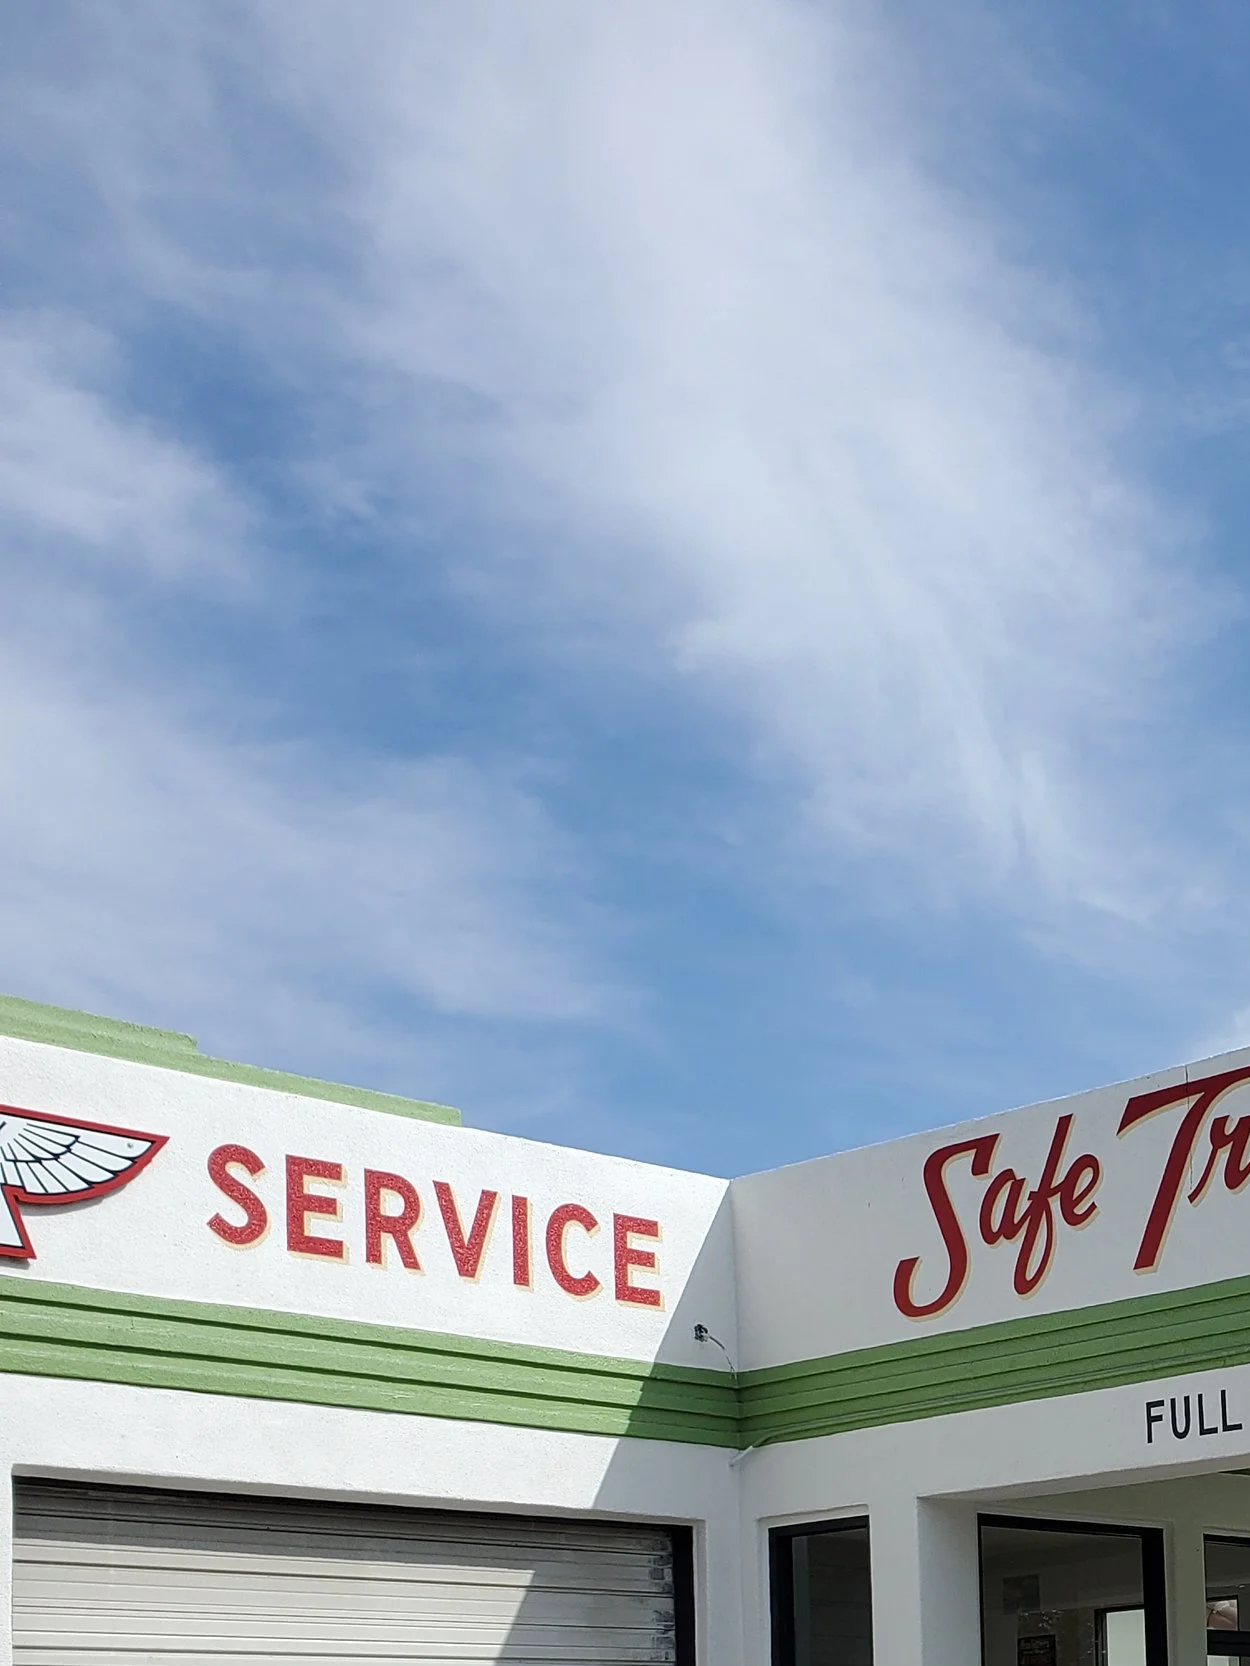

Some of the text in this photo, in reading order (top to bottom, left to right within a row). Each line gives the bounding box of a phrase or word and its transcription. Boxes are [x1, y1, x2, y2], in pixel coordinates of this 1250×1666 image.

[206, 1143, 665, 1311] SERVICE
[894, 1113, 1103, 1321] Safe
[1145, 1388, 1243, 1444] FULL
